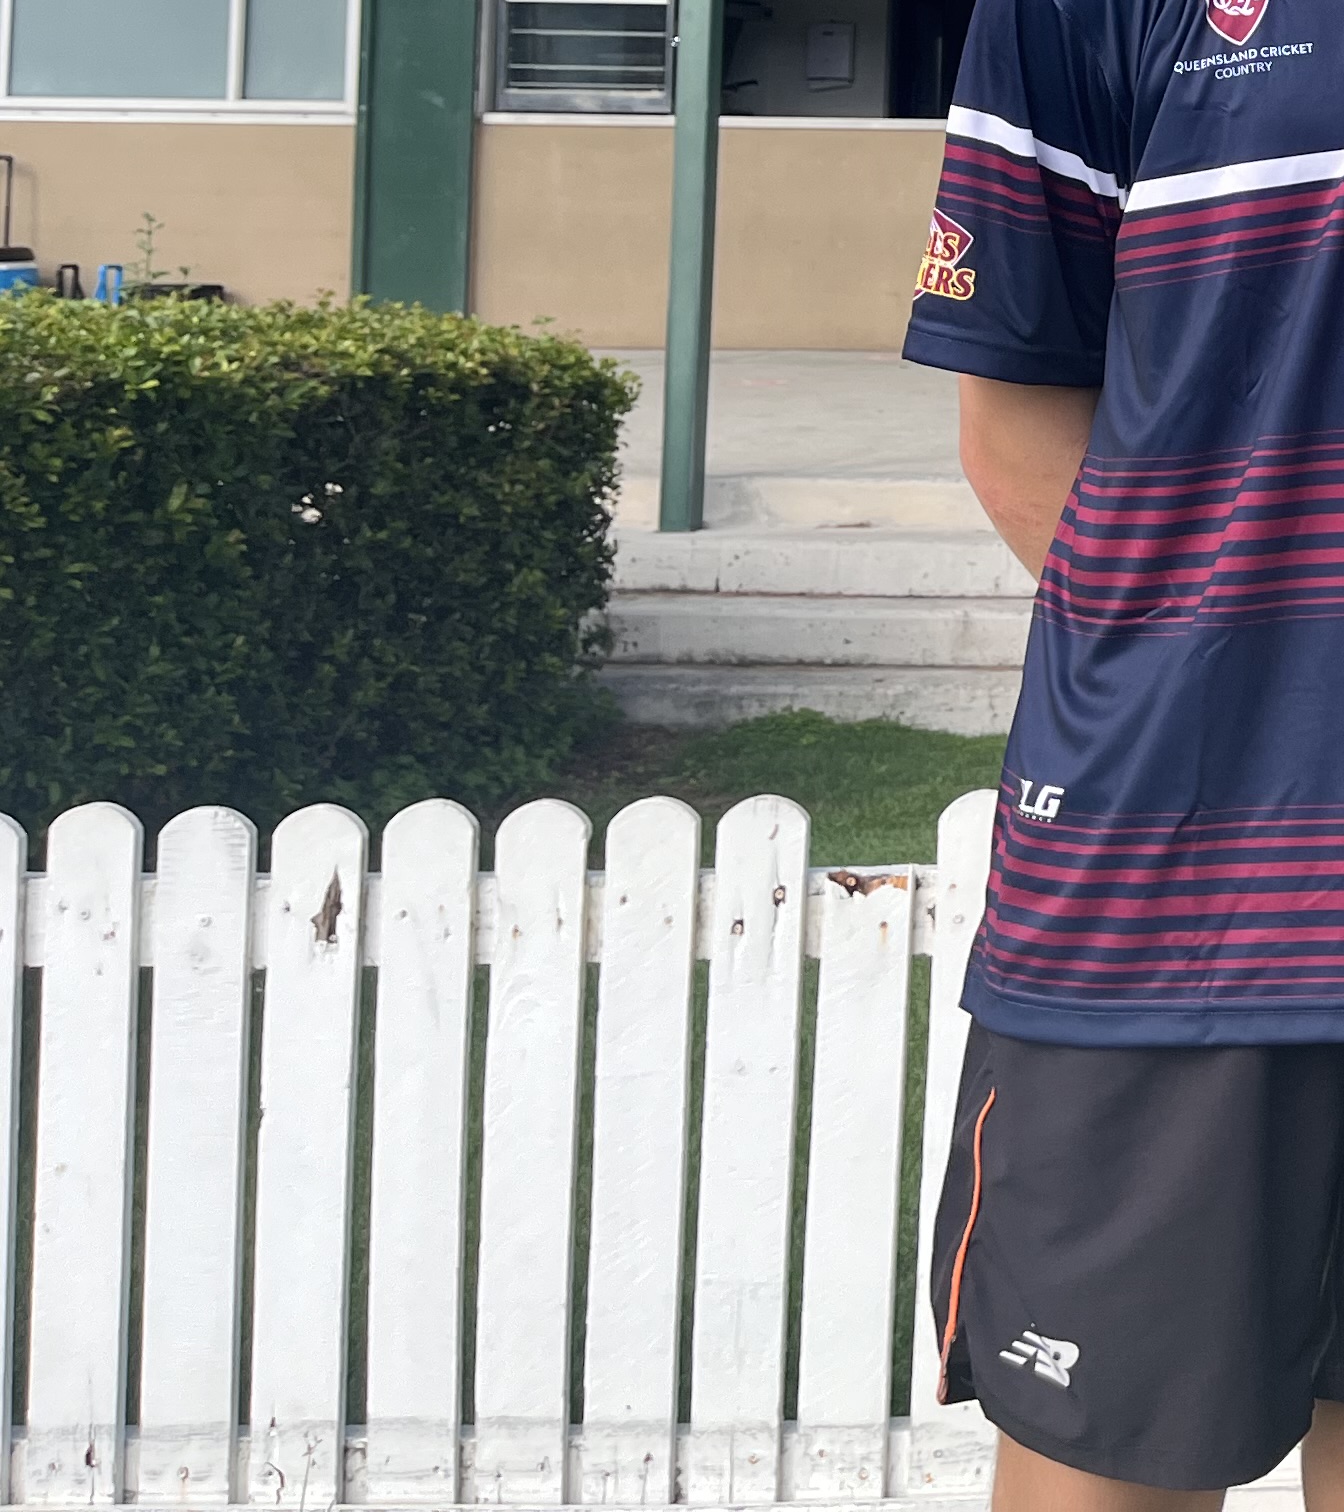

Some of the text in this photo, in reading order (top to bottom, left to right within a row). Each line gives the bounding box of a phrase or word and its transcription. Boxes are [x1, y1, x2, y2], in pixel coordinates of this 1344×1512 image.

[1173, 42, 1313, 74] QUEENSLAND CRICKET
[1215, 61, 1273, 80] COUNTRY
